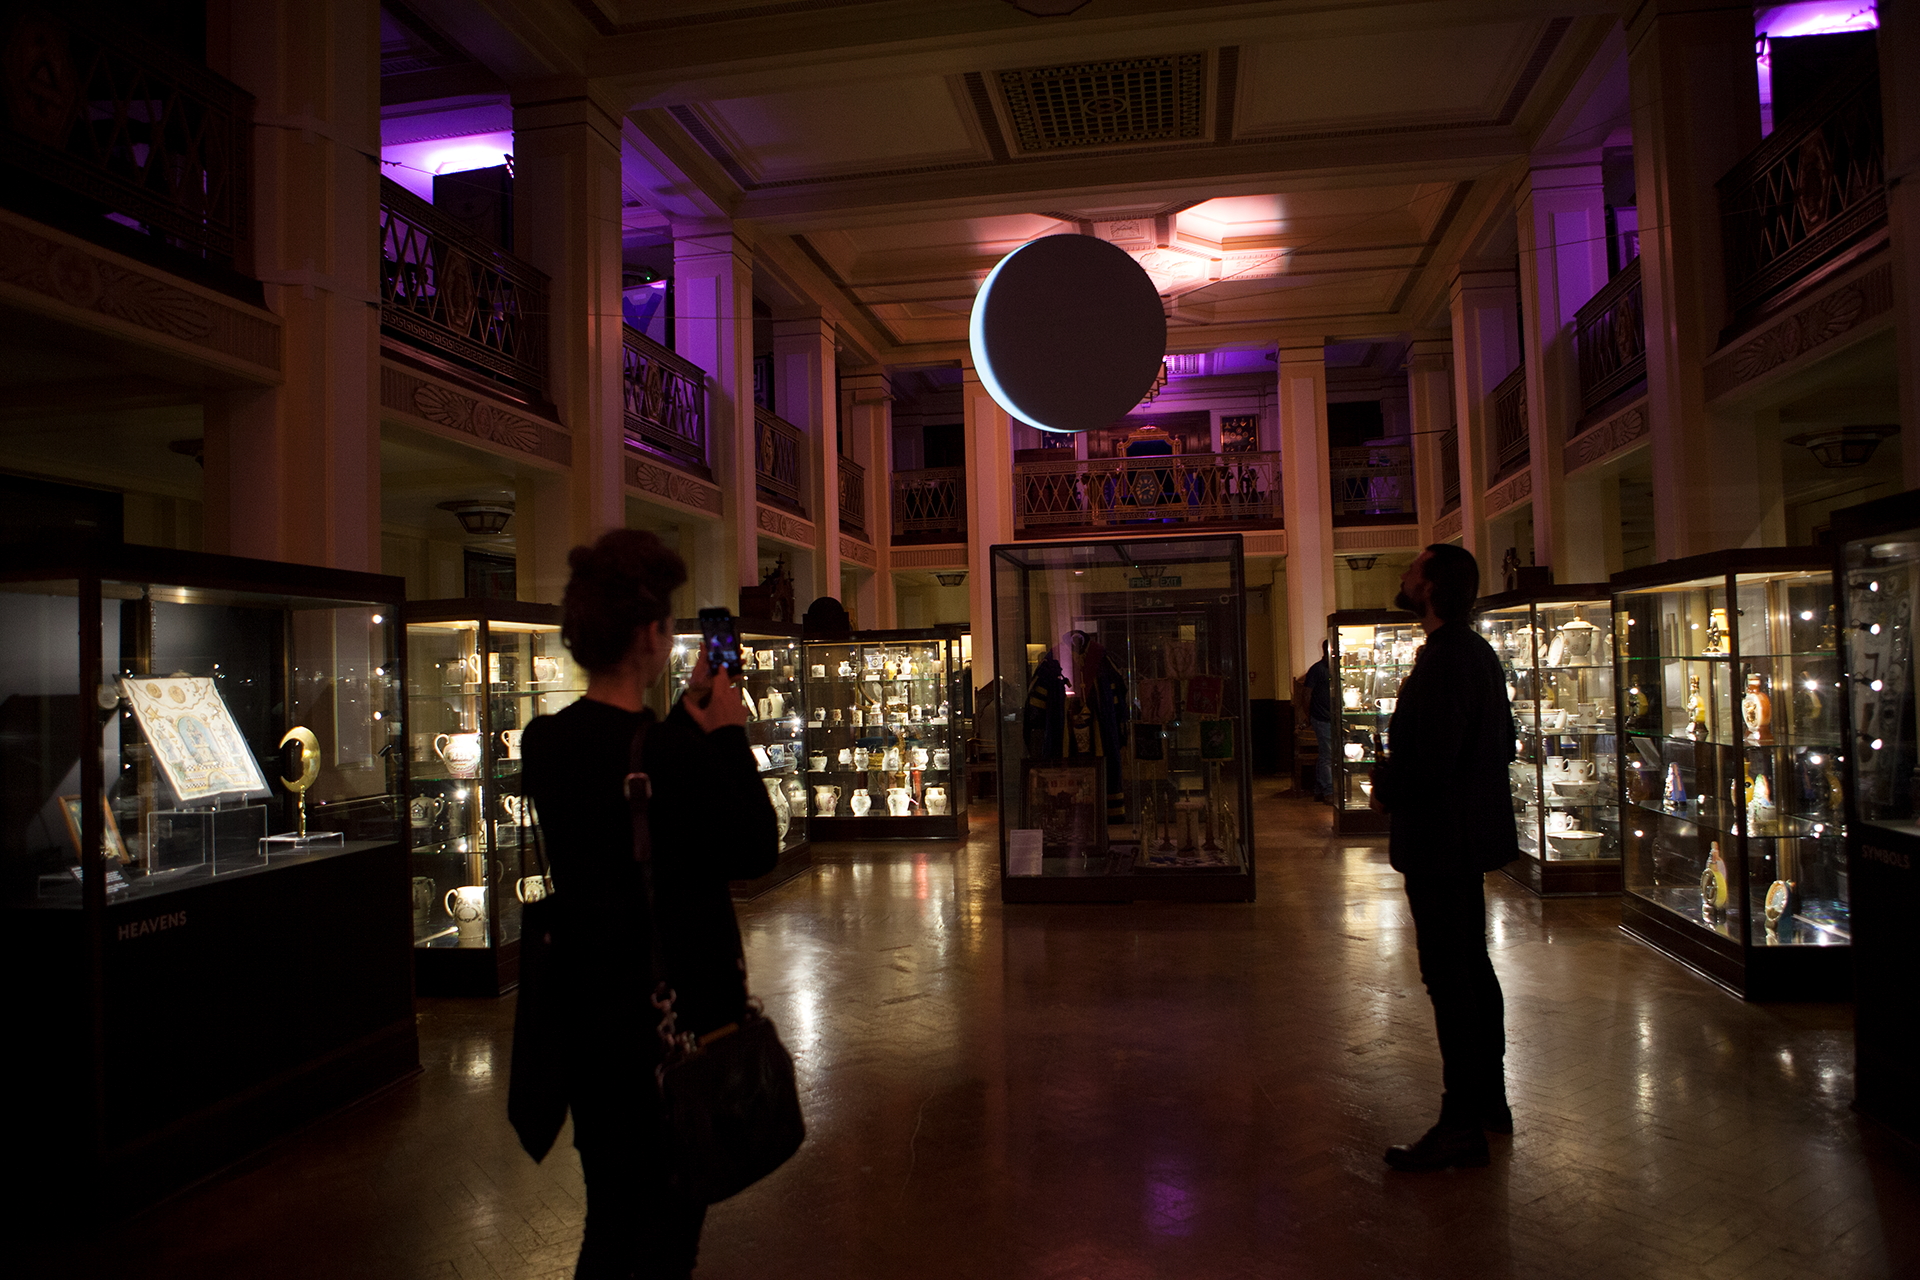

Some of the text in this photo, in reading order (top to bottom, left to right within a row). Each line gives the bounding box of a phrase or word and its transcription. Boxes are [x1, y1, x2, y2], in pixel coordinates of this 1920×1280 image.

[1132, 577, 1178, 587] FIRE EXIT
[1861, 844, 1911, 869] SYMBOLS
[118, 910, 187, 941] HEAVENS
